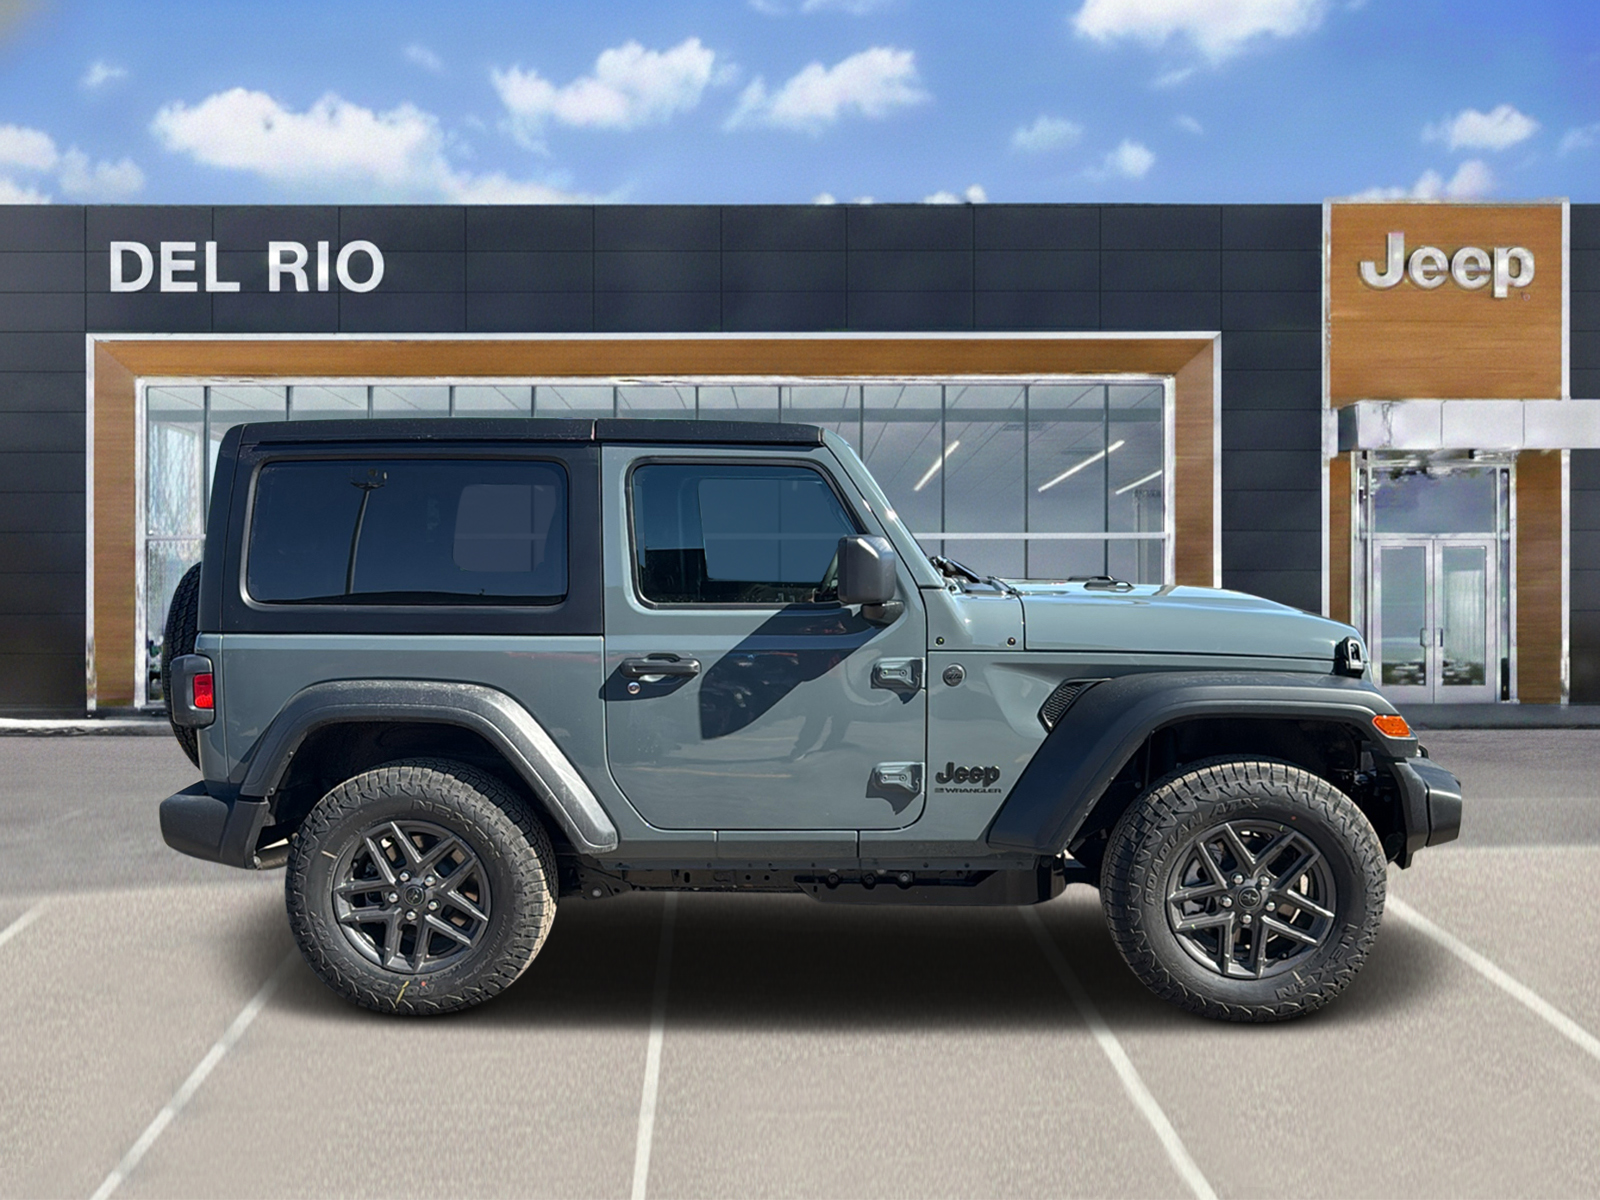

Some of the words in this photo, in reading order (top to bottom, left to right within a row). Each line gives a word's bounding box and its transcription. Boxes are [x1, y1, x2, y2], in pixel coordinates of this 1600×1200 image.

[110, 241, 240, 292] DEL
[268, 240, 384, 293] RIO
[1360, 231, 1535, 298] Jeep
[935, 761, 1000, 787] Jeep
[1144, 811, 1204, 906] ROADIAN
[1274, 922, 1359, 1000] NEXEN
